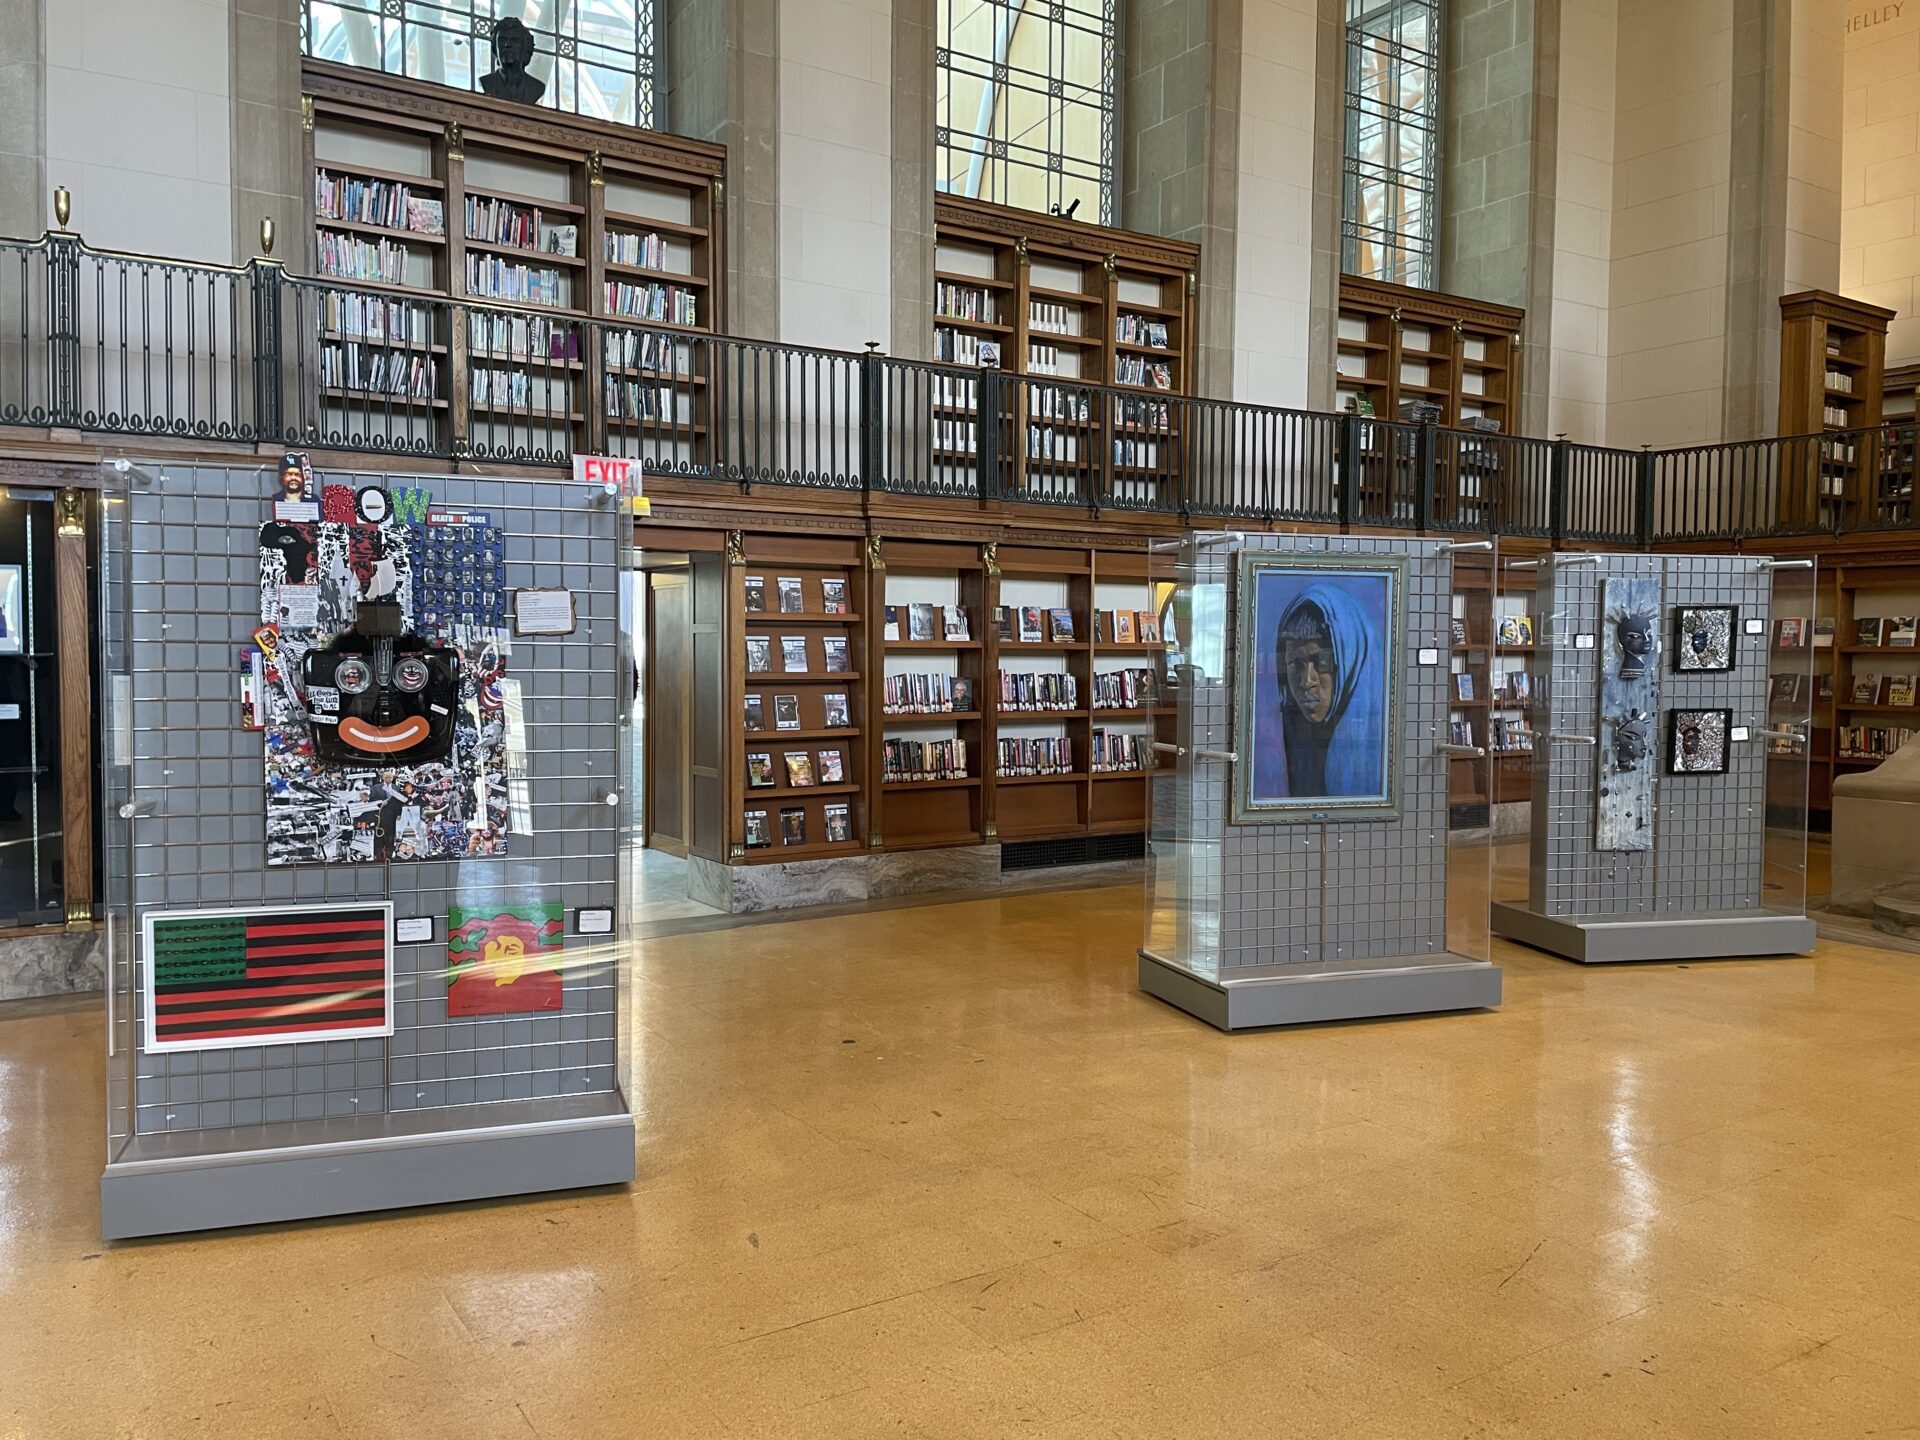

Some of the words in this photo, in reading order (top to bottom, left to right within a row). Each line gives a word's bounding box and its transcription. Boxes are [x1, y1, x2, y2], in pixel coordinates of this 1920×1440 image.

[585, 460, 630, 490] EXIT
[431, 514, 454, 522] DEATH
[462, 515, 486, 523] POLICE
